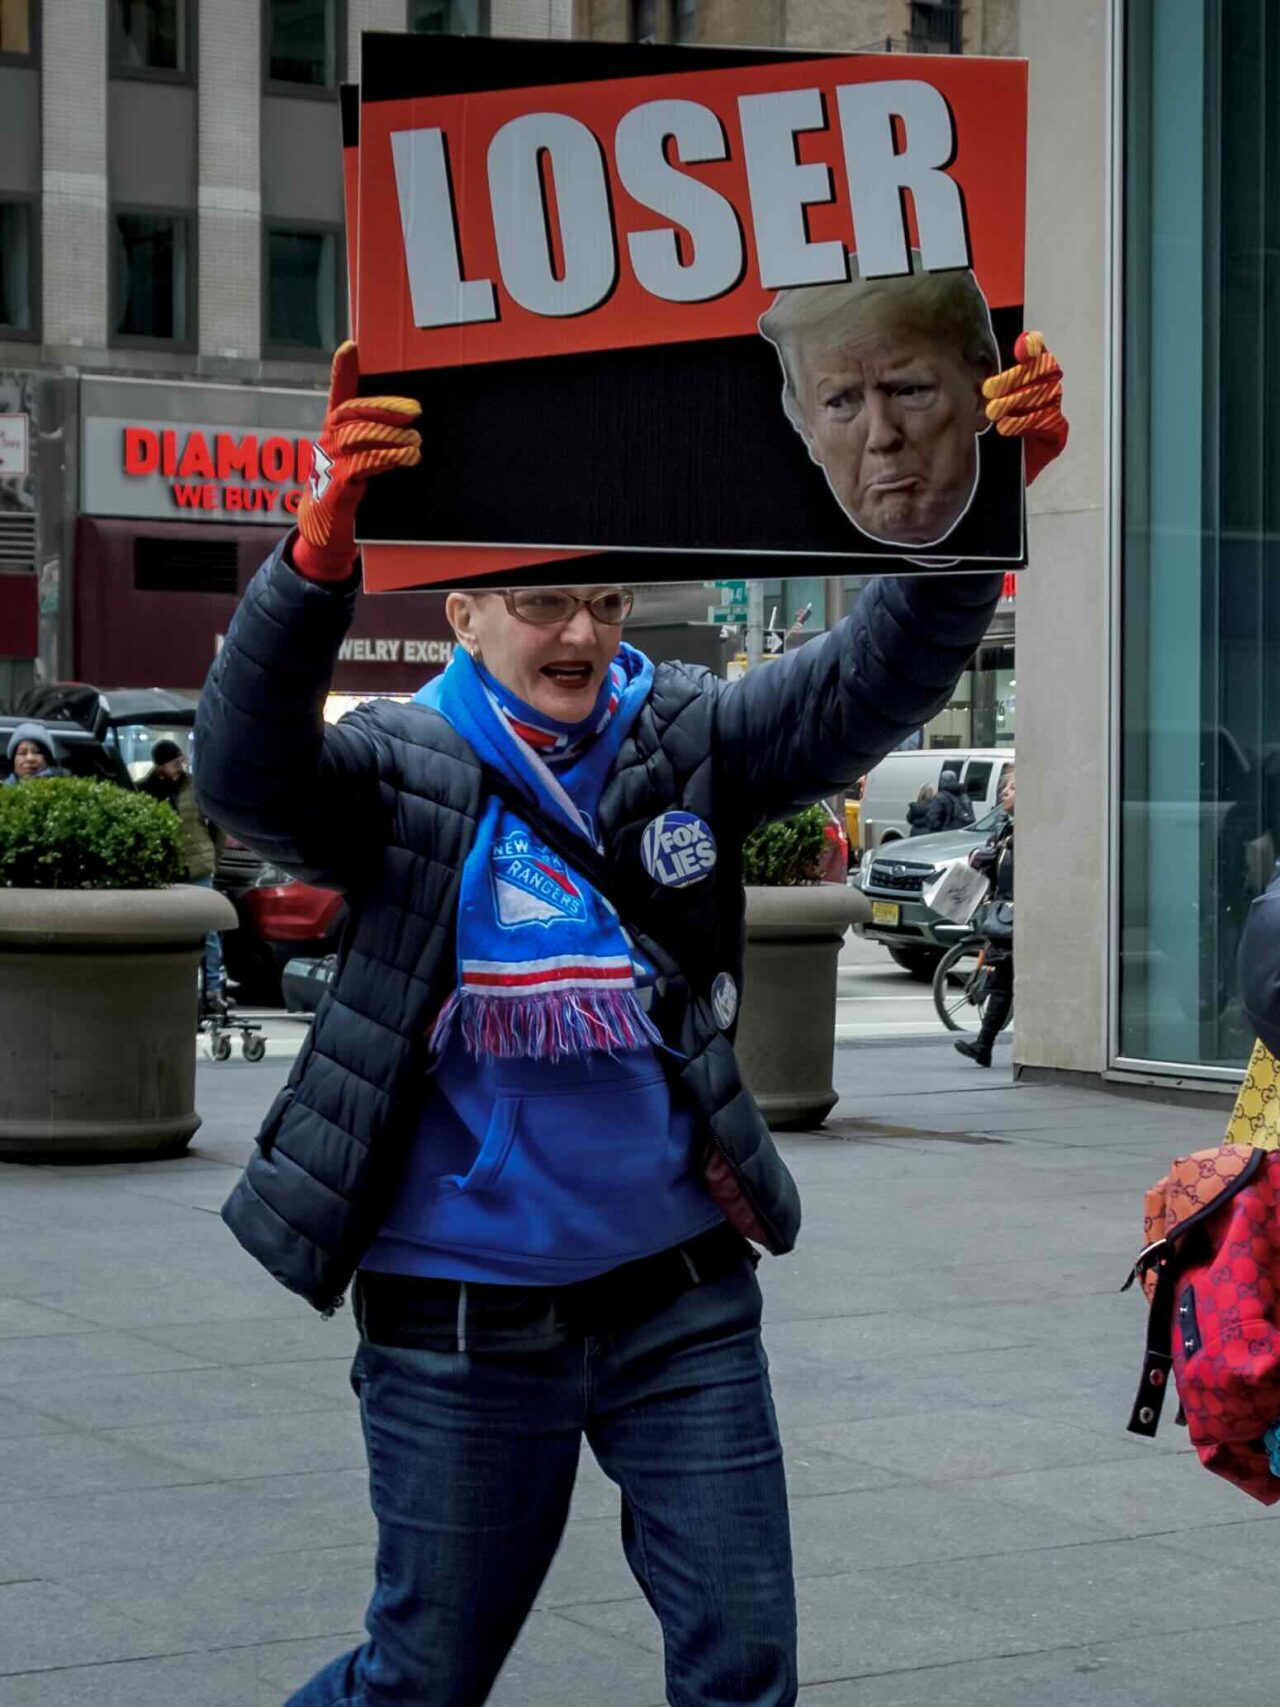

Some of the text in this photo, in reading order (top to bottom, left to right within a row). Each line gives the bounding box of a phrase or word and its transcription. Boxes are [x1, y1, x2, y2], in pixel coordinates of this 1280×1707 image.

[391, 79, 971, 328] LOSER
[174, 484, 218, 510] WE
[225, 486, 279, 513] BUY
[338, 638, 453, 662] WELRY EXCH
[493, 839, 529, 855] NEW
[660, 819, 708, 854] FOX
[655, 840, 717, 883] LIES
[506, 860, 580, 914] RANGERS
